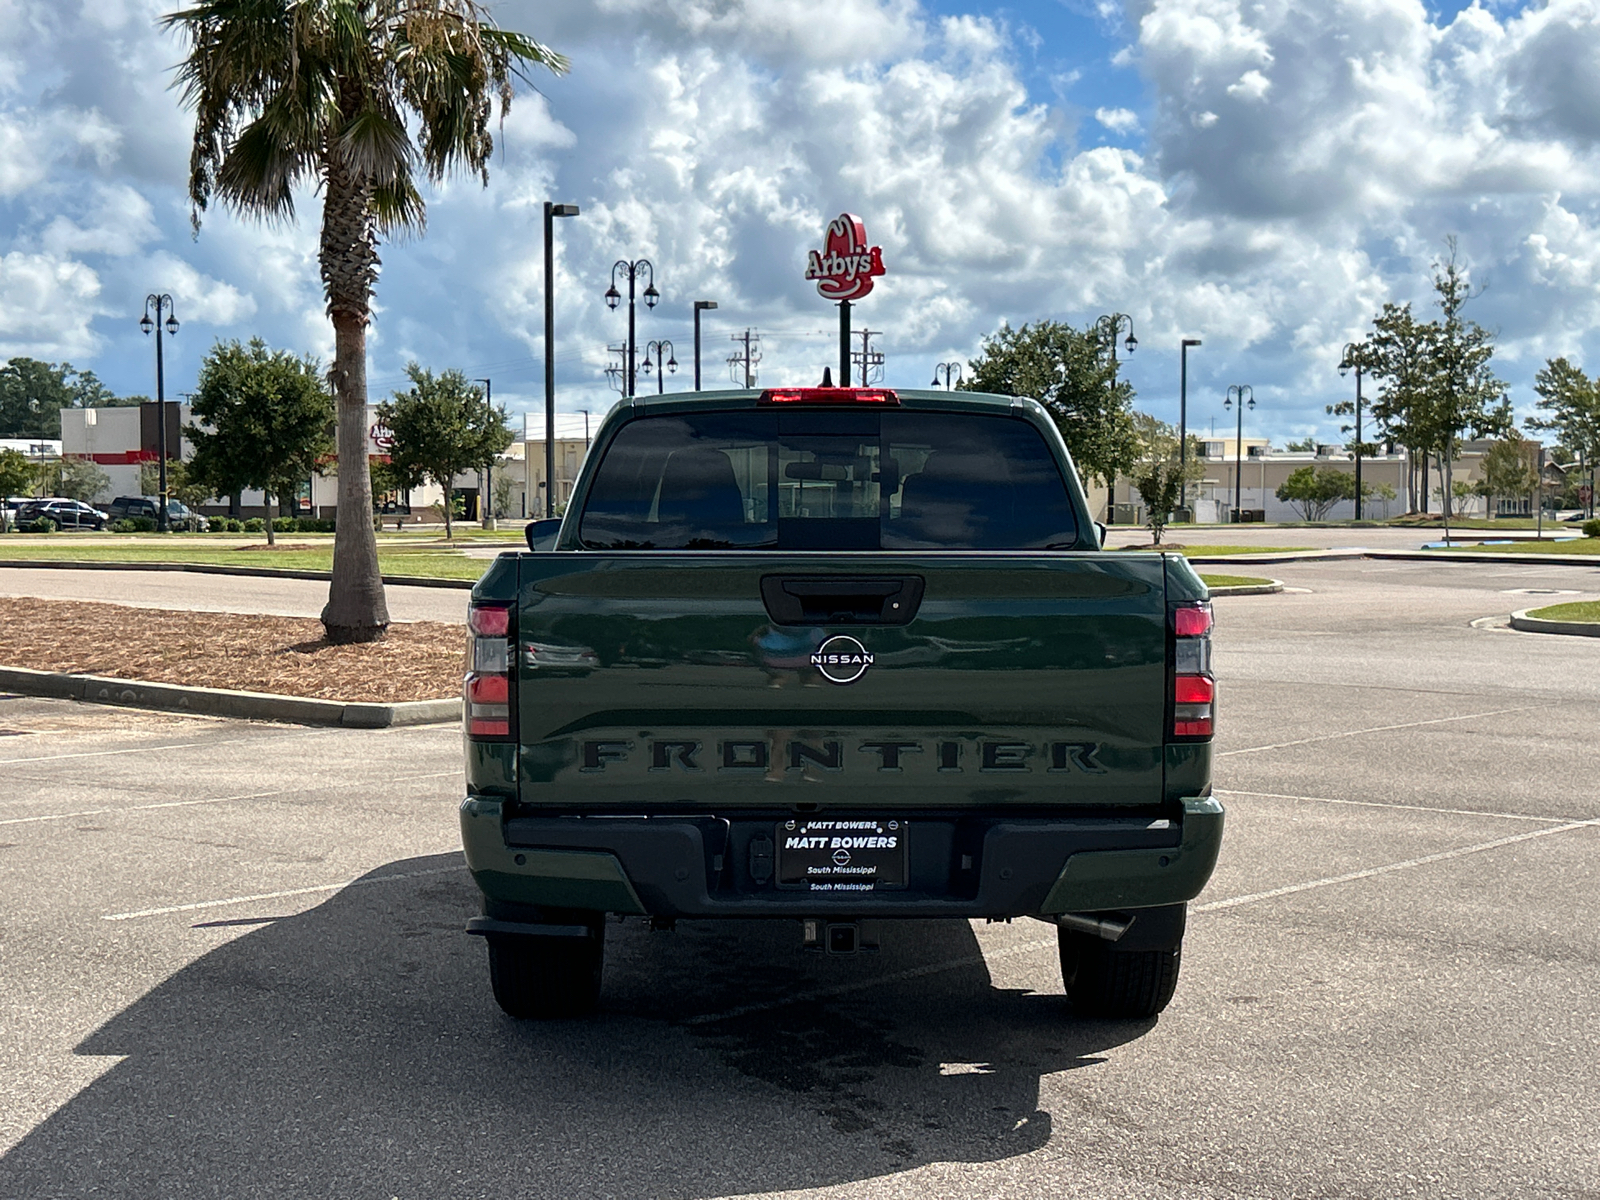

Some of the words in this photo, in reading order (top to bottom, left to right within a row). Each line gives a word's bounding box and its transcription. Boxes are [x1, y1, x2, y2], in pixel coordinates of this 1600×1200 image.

[806, 247, 872, 282] Arby's
[810, 654, 874, 664] NISSAN
[580, 740, 1107, 773] FRONTIER
[807, 821, 834, 830] MATT
[835, 821, 877, 830] BOWERS
[785, 837, 828, 849] MATT
[830, 837, 897, 849] BOWERS
[807, 866, 831, 874] South
[832, 866, 877, 875] Mississippi
[810, 883, 832, 891] South
[833, 883, 874, 892] Mississippi
